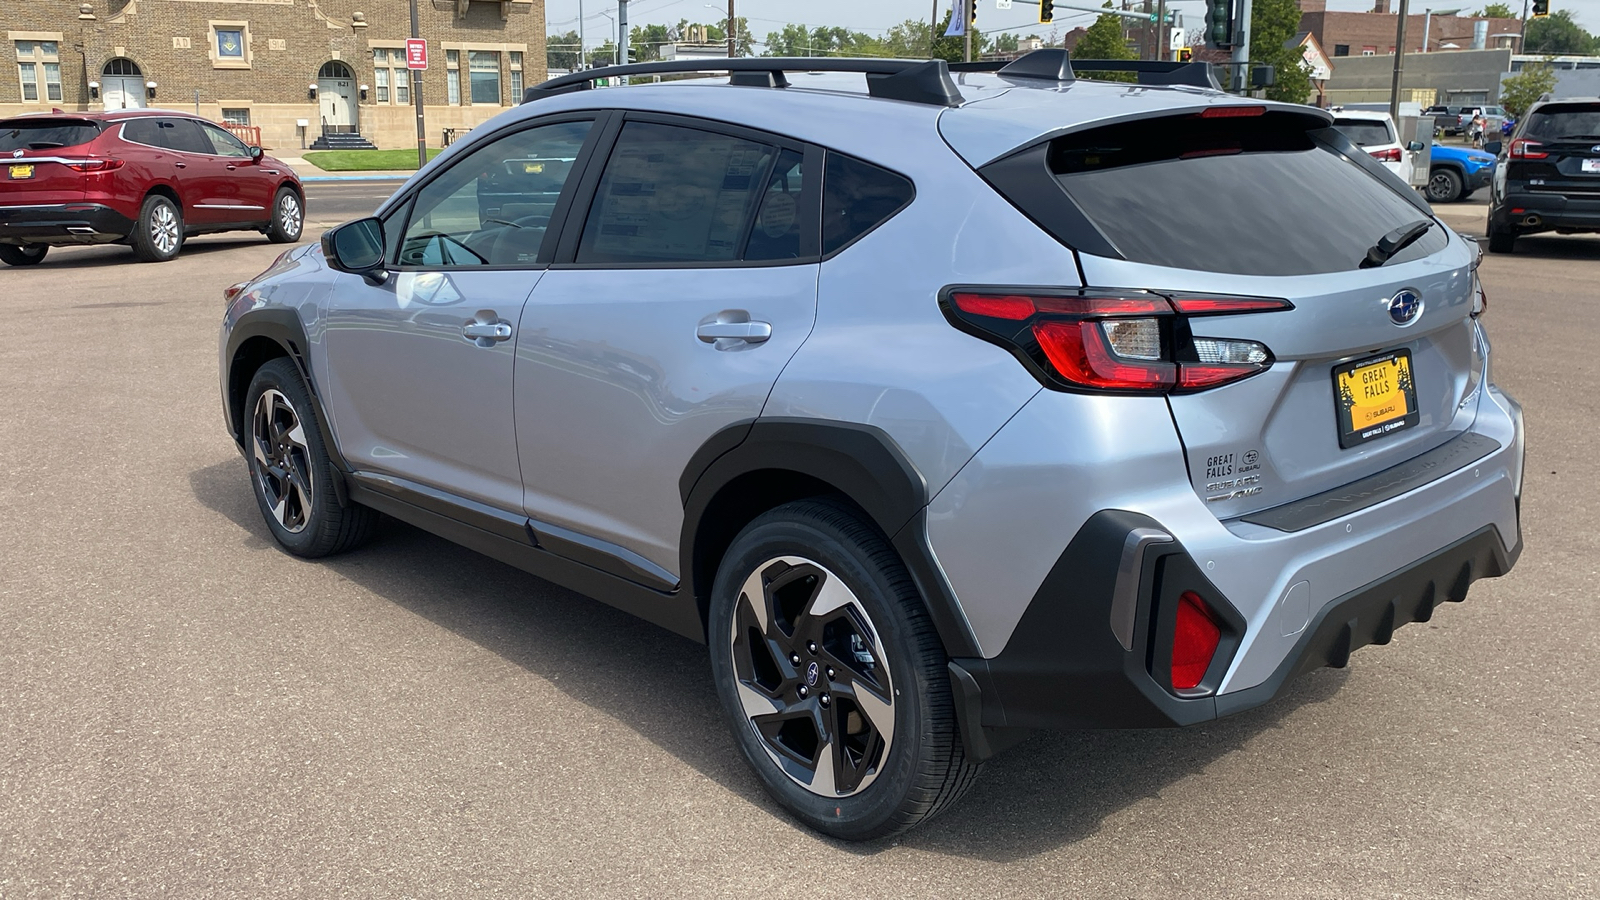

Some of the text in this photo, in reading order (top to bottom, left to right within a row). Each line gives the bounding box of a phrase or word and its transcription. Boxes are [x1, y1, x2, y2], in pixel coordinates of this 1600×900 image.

[269, 40, 285, 49] 1914
[1362, 367, 1387, 384] GREAT
[1364, 380, 1390, 399] FALLS
[1373, 405, 1396, 418] SUBARU
[1207, 453, 1233, 467] GREAT
[1206, 464, 1233, 479] FALLS
[1238, 464, 1261, 473] SUBARU
[1206, 474, 1260, 492] SUBARU
